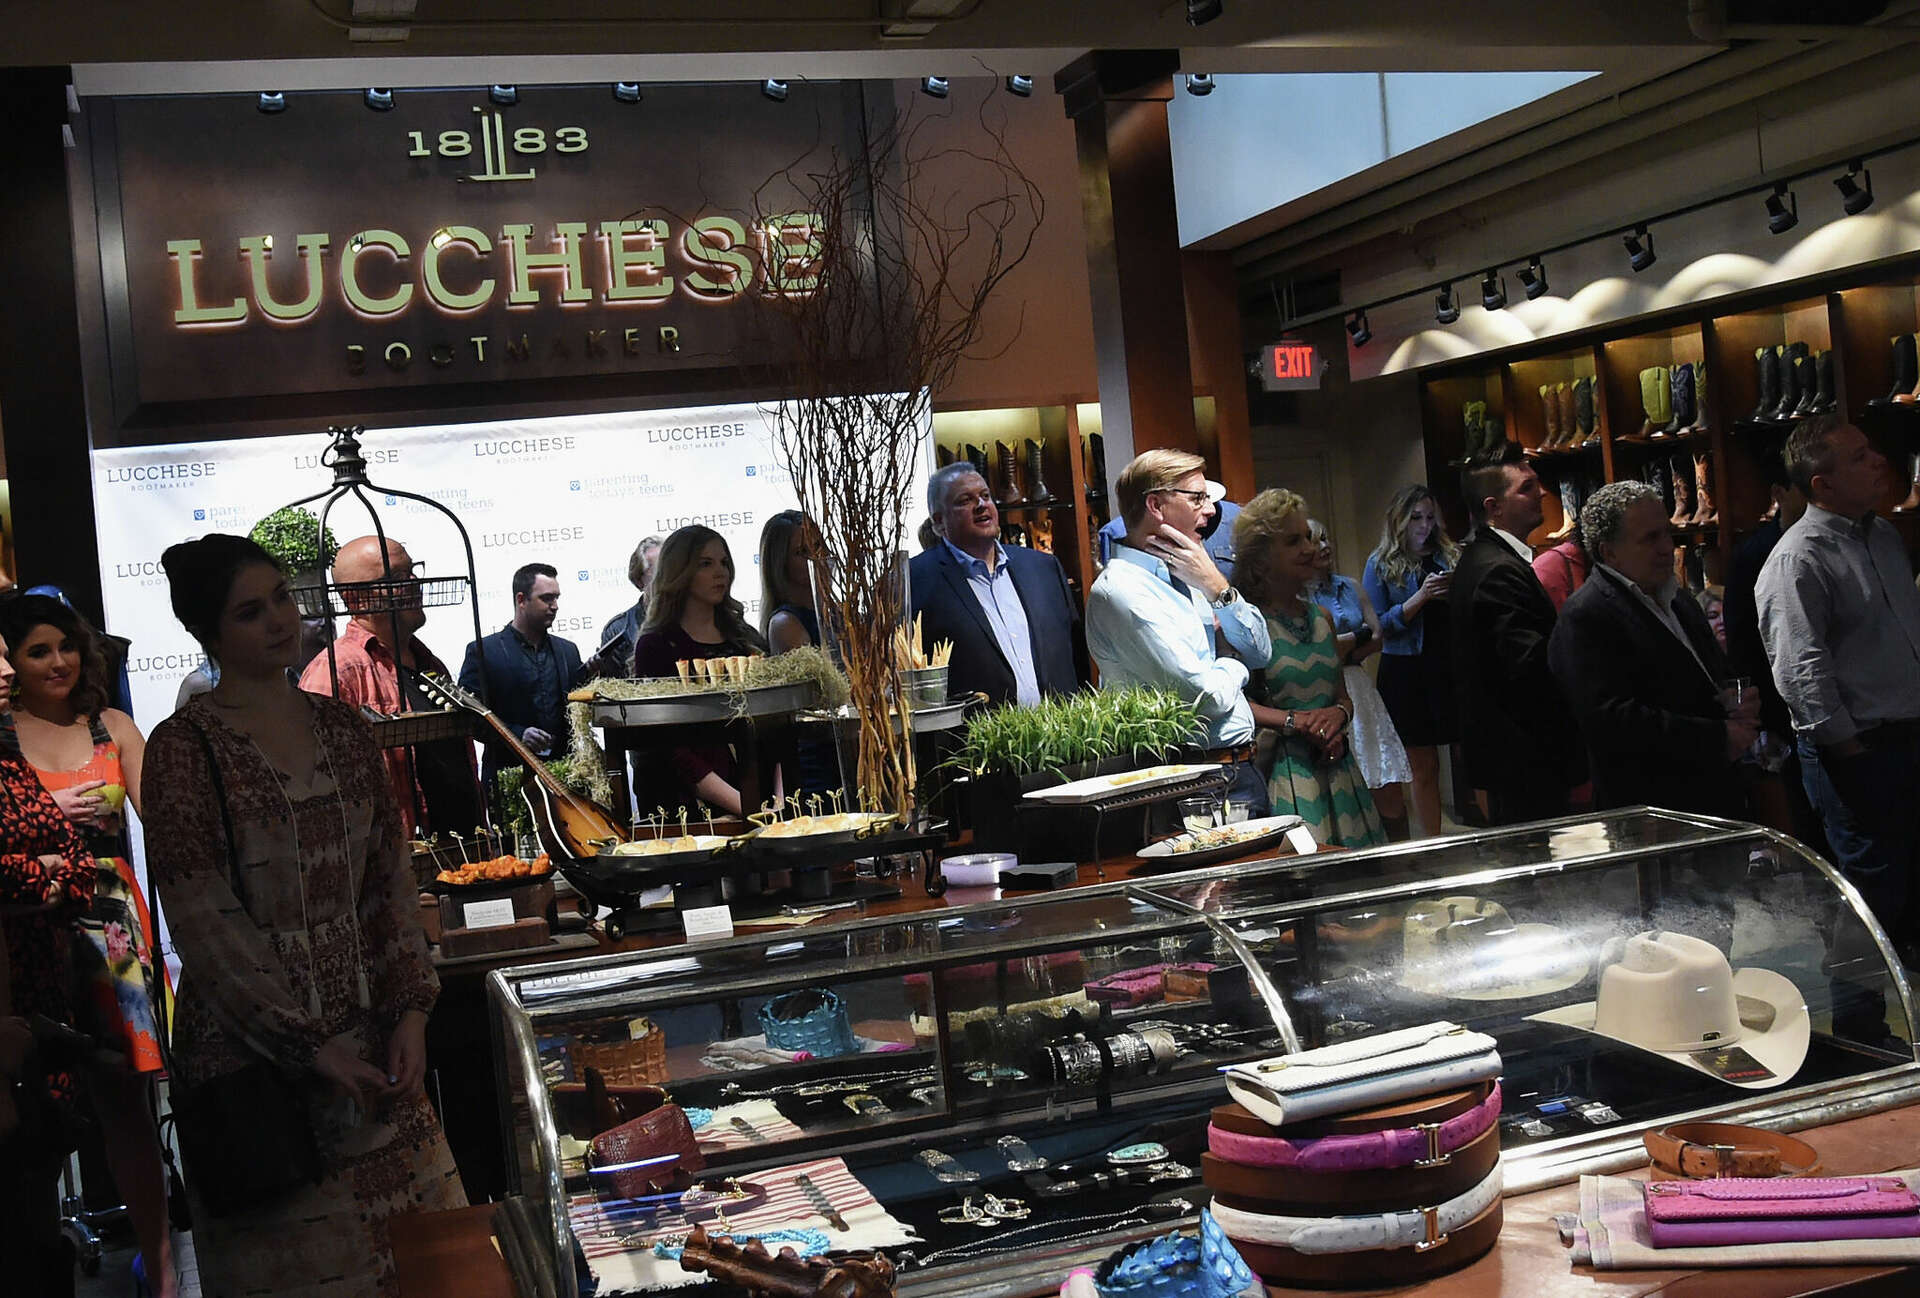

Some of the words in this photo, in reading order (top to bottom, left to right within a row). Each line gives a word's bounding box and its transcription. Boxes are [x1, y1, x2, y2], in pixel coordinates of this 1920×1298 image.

[166, 213, 828, 327] LUCCHESE
[346, 326, 681, 375] BOOTMAKER
[1275, 347, 1312, 377] EXIT
[647, 423, 745, 443] LUCCHESE
[474, 436, 575, 457] LUCCHESE
[669, 440, 726, 451] BOOTMAKER
[295, 450, 400, 470] LUESE
[107, 462, 216, 483] LUCCHESE
[131, 482, 195, 492] BOOTMAKER
[639, 482, 675, 495] teens
[483, 526, 584, 548] LUCCHESE
